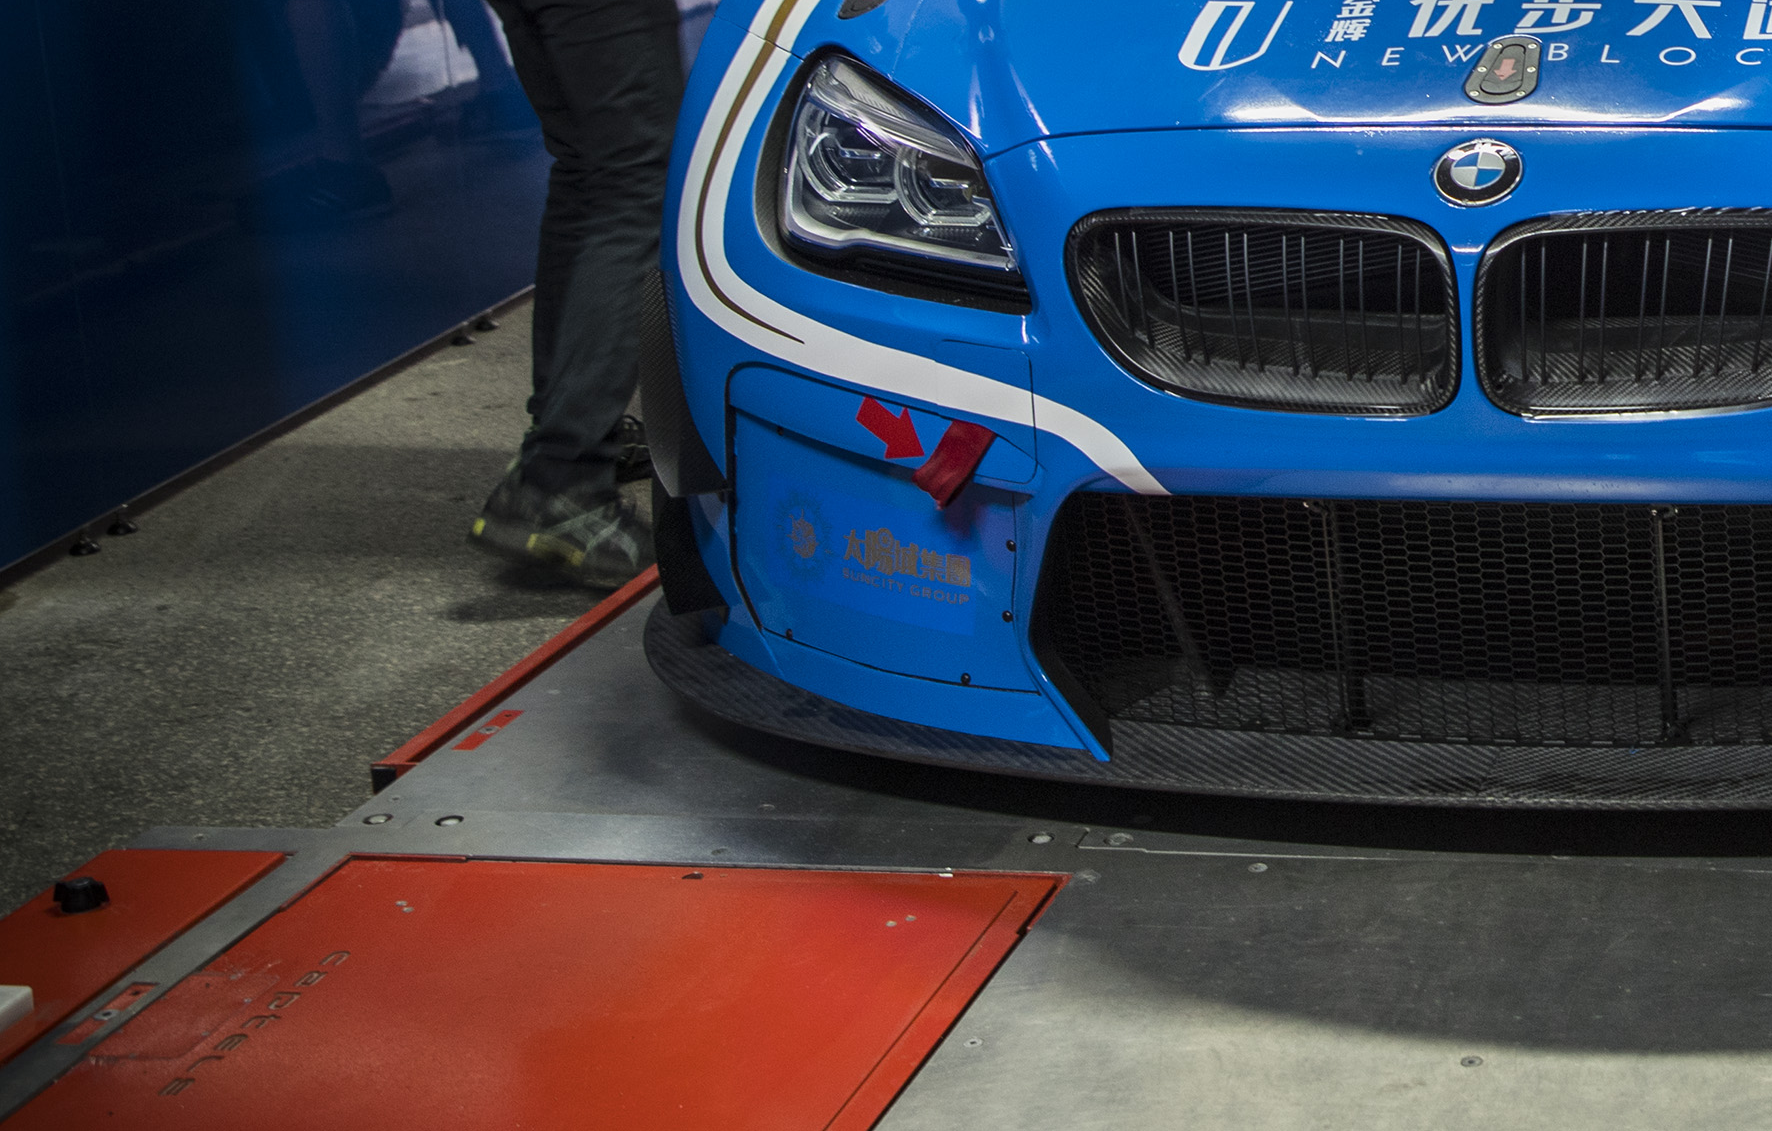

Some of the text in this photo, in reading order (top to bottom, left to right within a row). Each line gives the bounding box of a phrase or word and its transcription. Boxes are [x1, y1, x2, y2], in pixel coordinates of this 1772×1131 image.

[1310, 44, 1486, 70] NEW
[842, 566, 970, 605] SUNCITY GROUP
